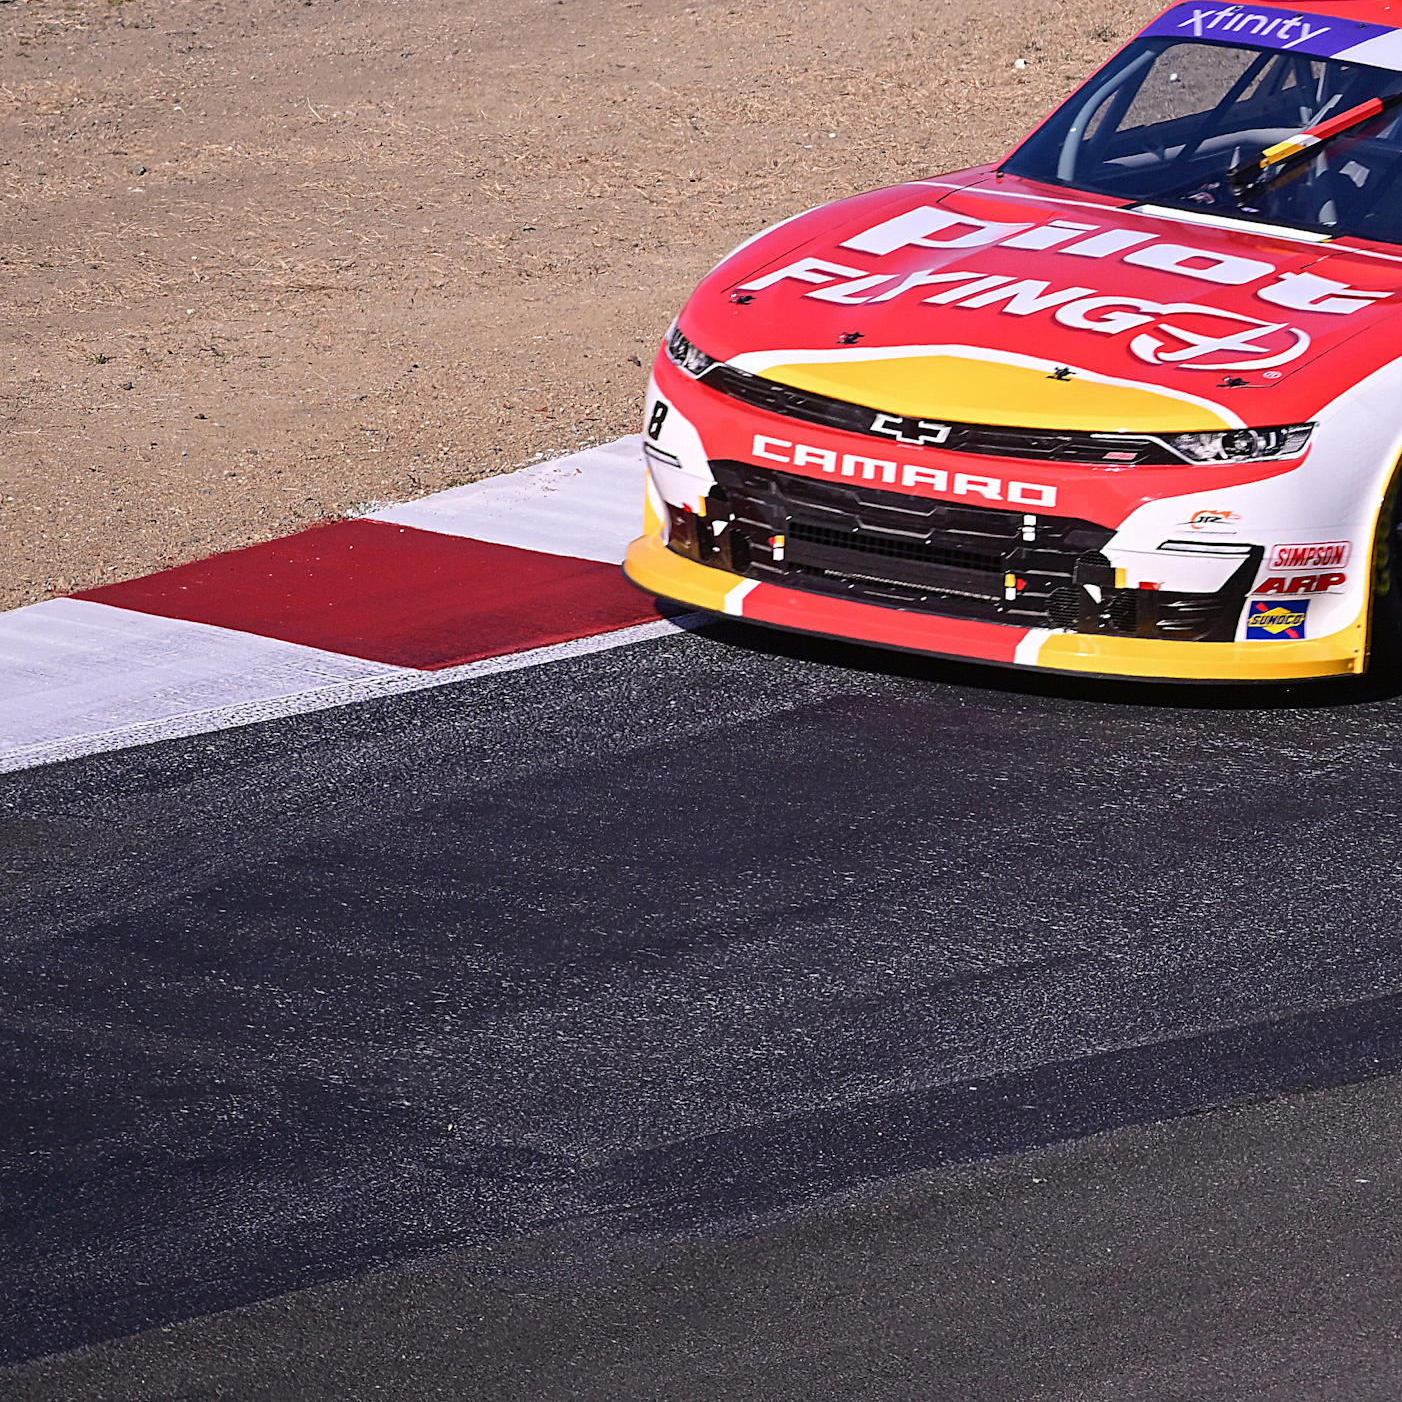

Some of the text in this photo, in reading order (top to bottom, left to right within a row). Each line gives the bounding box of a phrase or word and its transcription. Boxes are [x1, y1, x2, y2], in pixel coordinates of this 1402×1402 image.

[1178, 8, 1331, 50] xfinity
[746, 256, 1167, 335] FLYING
[649, 400, 668, 441] 8
[752, 434, 1057, 508] CAMARO
[1274, 545, 1345, 568] SIMPSON
[1251, 573, 1348, 594] ARP
[1250, 614, 1304, 626] SUNOCO
